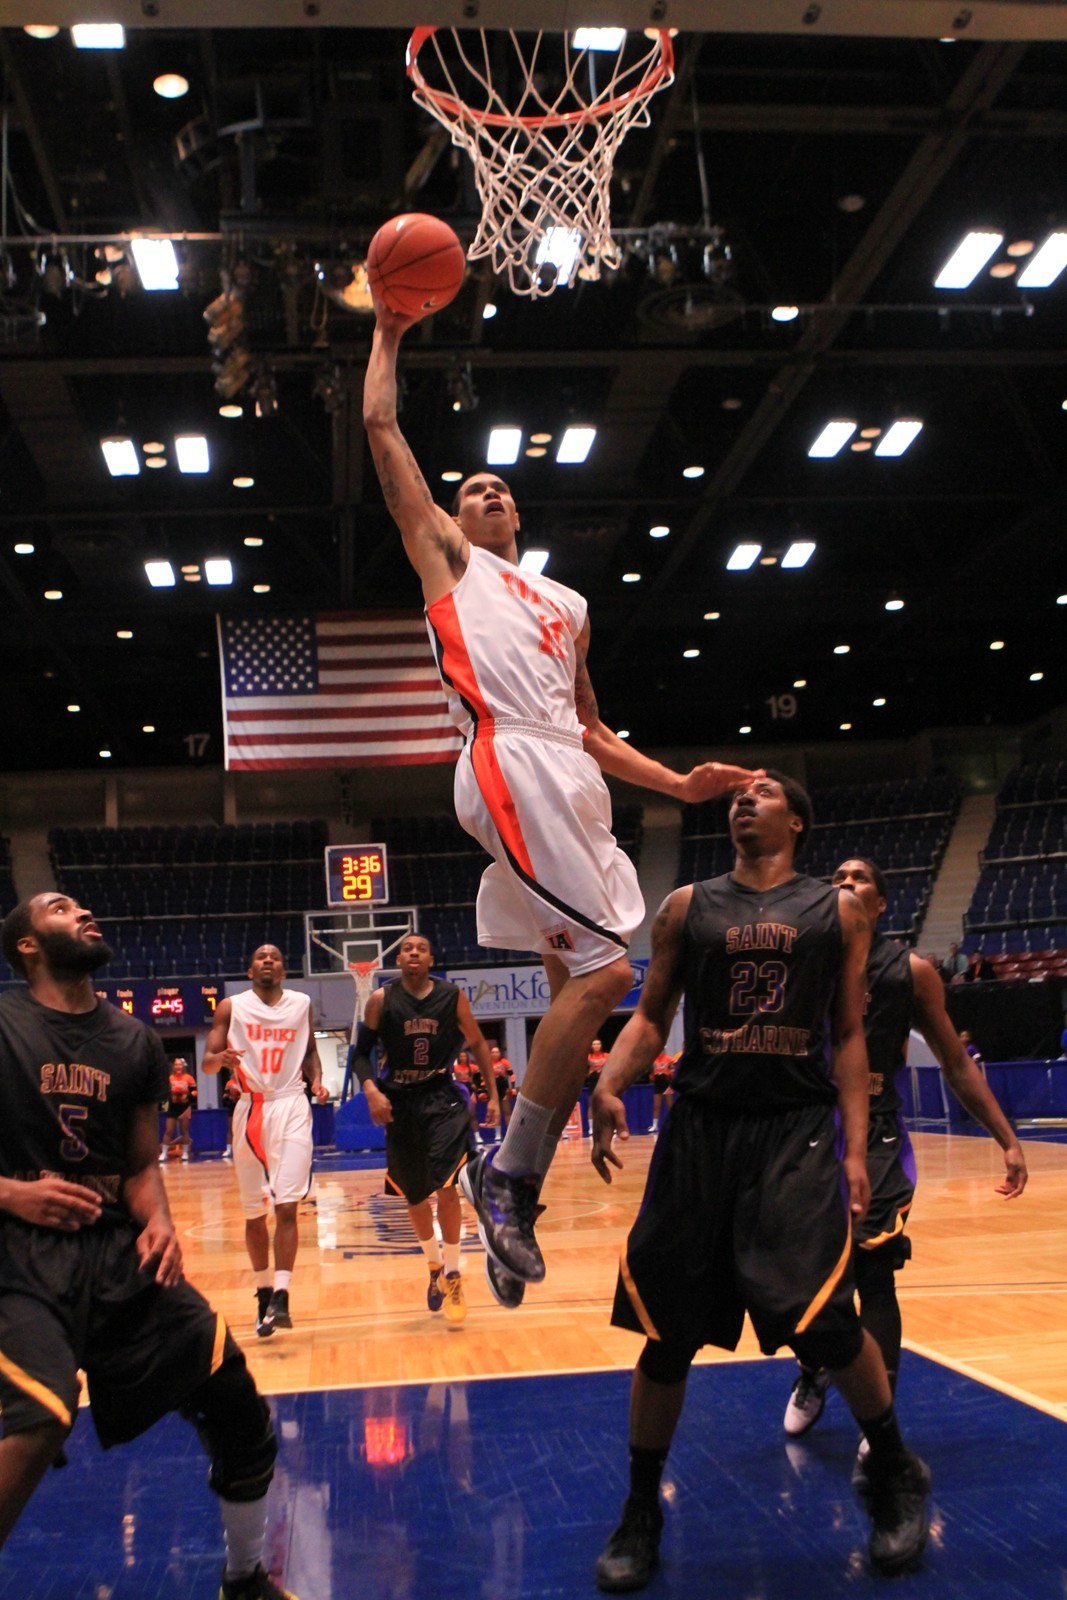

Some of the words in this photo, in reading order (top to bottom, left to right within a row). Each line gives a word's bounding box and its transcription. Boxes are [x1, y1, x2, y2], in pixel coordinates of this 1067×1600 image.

[765, 694, 797, 719] 19
[184, 733, 211, 757] 17
[342, 855, 381, 874] 3:36
[342, 875, 372, 899] 29
[726, 922, 798, 955] SAINT
[729, 960, 788, 1016] 23
[122, 1001, 133, 1014] 4
[207, 997, 216, 1011] 7
[404, 1018, 439, 1036] SAINT
[260, 1047, 285, 1074] 10
[413, 1038, 430, 1065] 2
[40, 1063, 110, 1102] SAINT
[58, 1104, 89, 1161] 5
